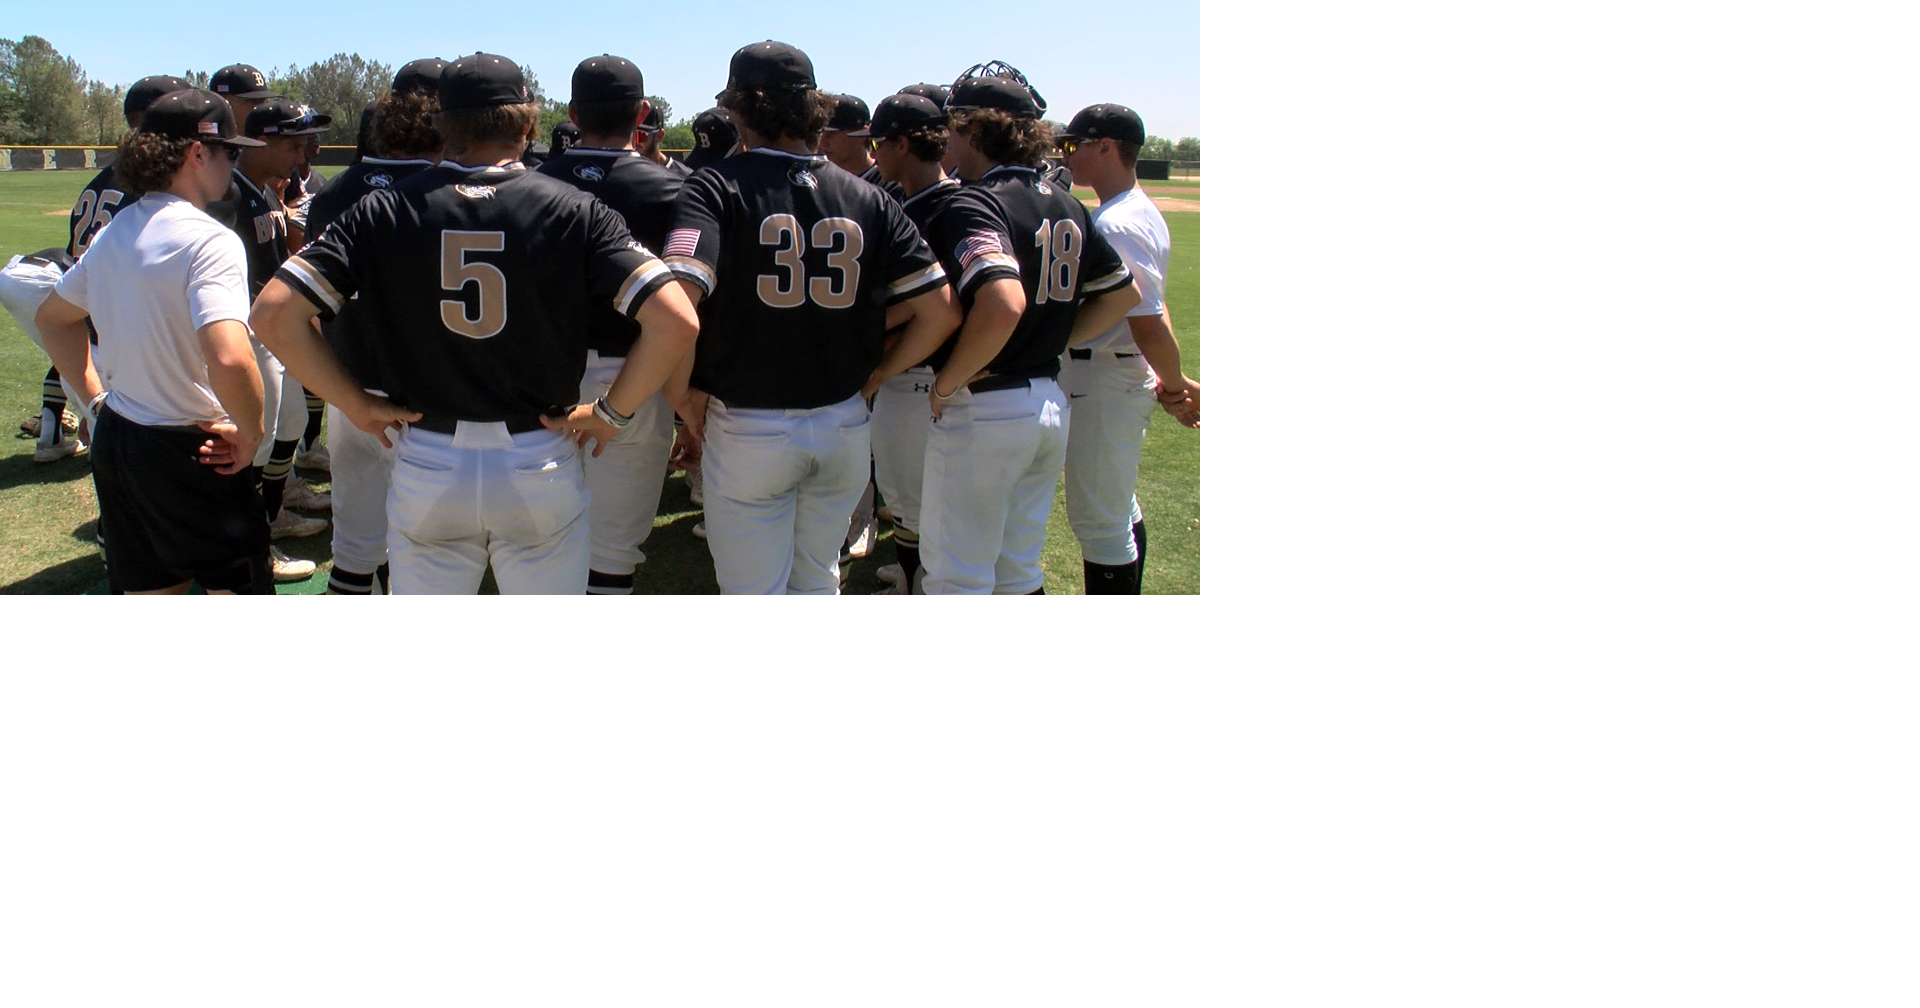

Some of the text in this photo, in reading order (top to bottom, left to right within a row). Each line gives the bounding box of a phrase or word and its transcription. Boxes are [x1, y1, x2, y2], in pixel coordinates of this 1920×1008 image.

[252, 71, 264, 86] B
[561, 135, 571, 149] B
[698, 132, 711, 148] B
[73, 189, 124, 257] 25
[440, 229, 507, 339] 5
[757, 213, 864, 308] 33
[1035, 218, 1082, 304] 18
